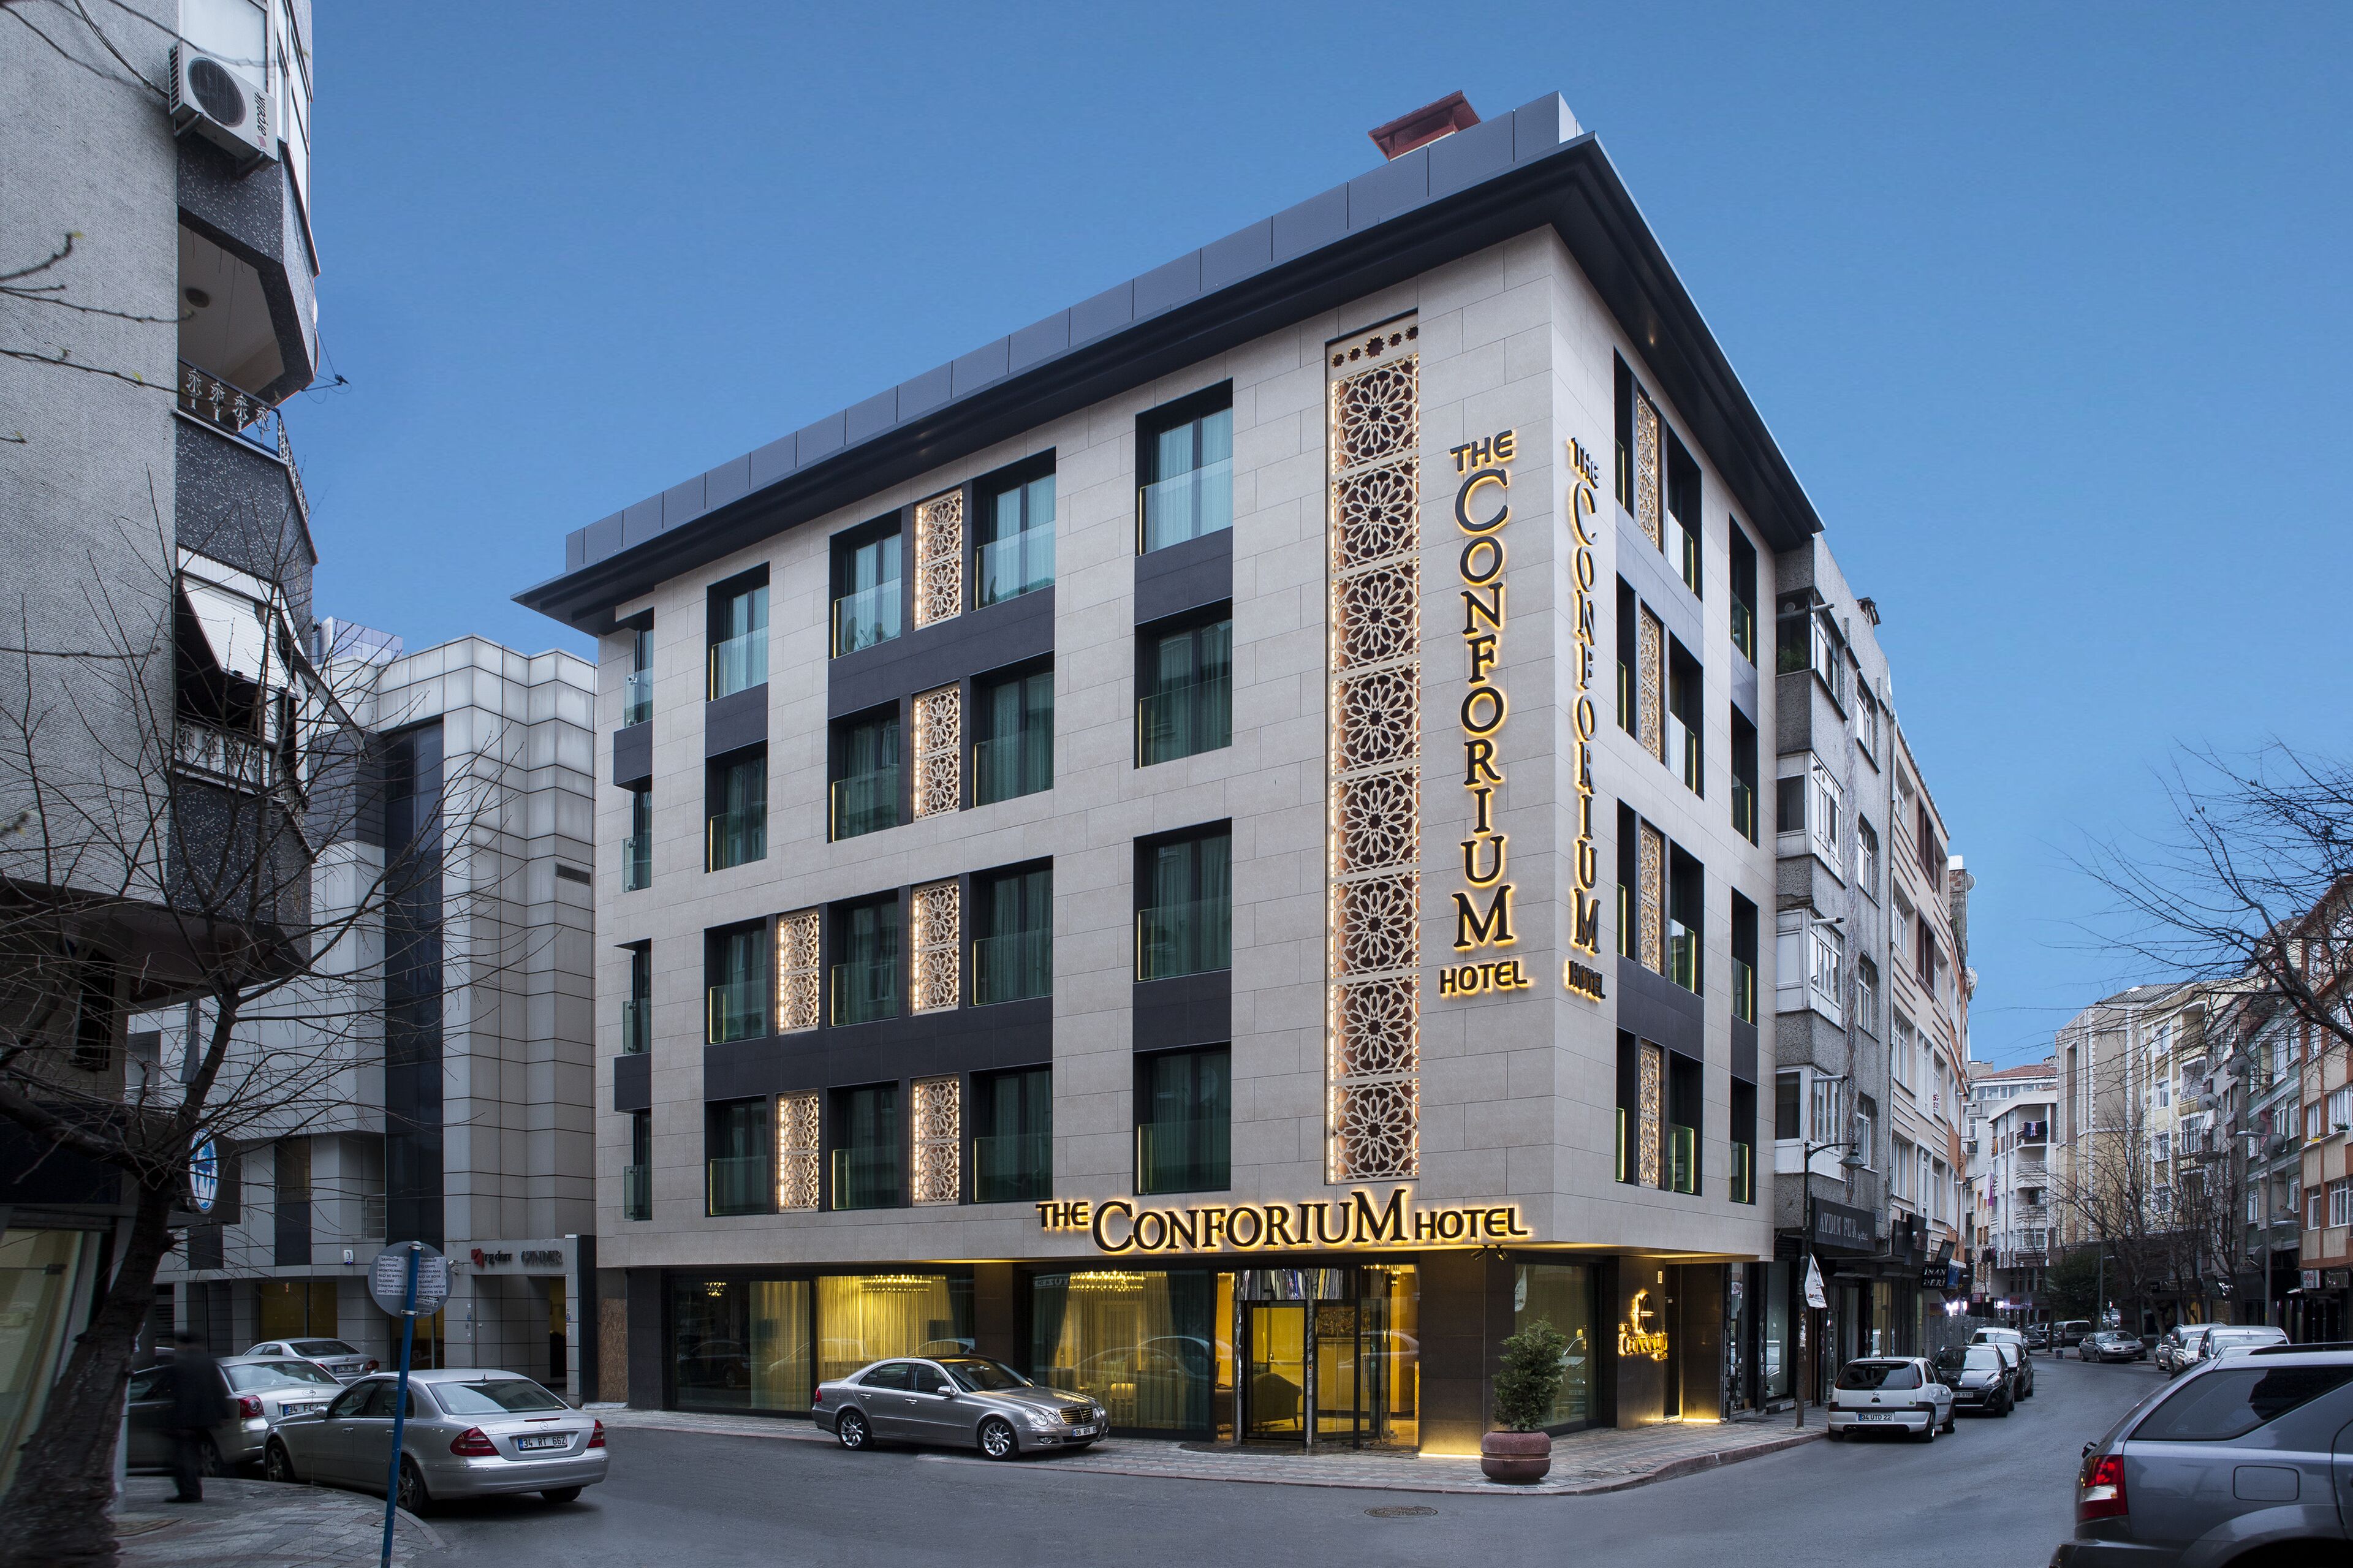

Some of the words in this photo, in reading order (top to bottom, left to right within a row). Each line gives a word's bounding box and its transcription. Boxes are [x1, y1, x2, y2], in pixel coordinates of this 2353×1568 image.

[254, 91, 268, 137] arçelik
[1450, 430, 1514, 472] THE
[1571, 436, 1599, 490] THE
[1452, 469, 1515, 948] CONFORIUM
[1571, 481, 1601, 955] CONFORIUM
[1439, 960, 1529, 995] HOTEL
[1568, 960, 1607, 1000] HOTEL
[1036, 1201, 1089, 1228] THE
[1093, 1189, 1409, 1252] CONFORIUM
[1414, 1207, 1528, 1240] HOTEL
[1819, 1211, 1841, 1236] AYDIN
[1843, 1217, 1857, 1238] FUR
[1923, 1266, 1947, 1276] İNAN
[1923, 1278, 1946, 1287] DERİ
[523, 1439, 533, 1447] 34
[539, 1437, 547, 1446] RT
[552, 1436, 567, 1445] 662
